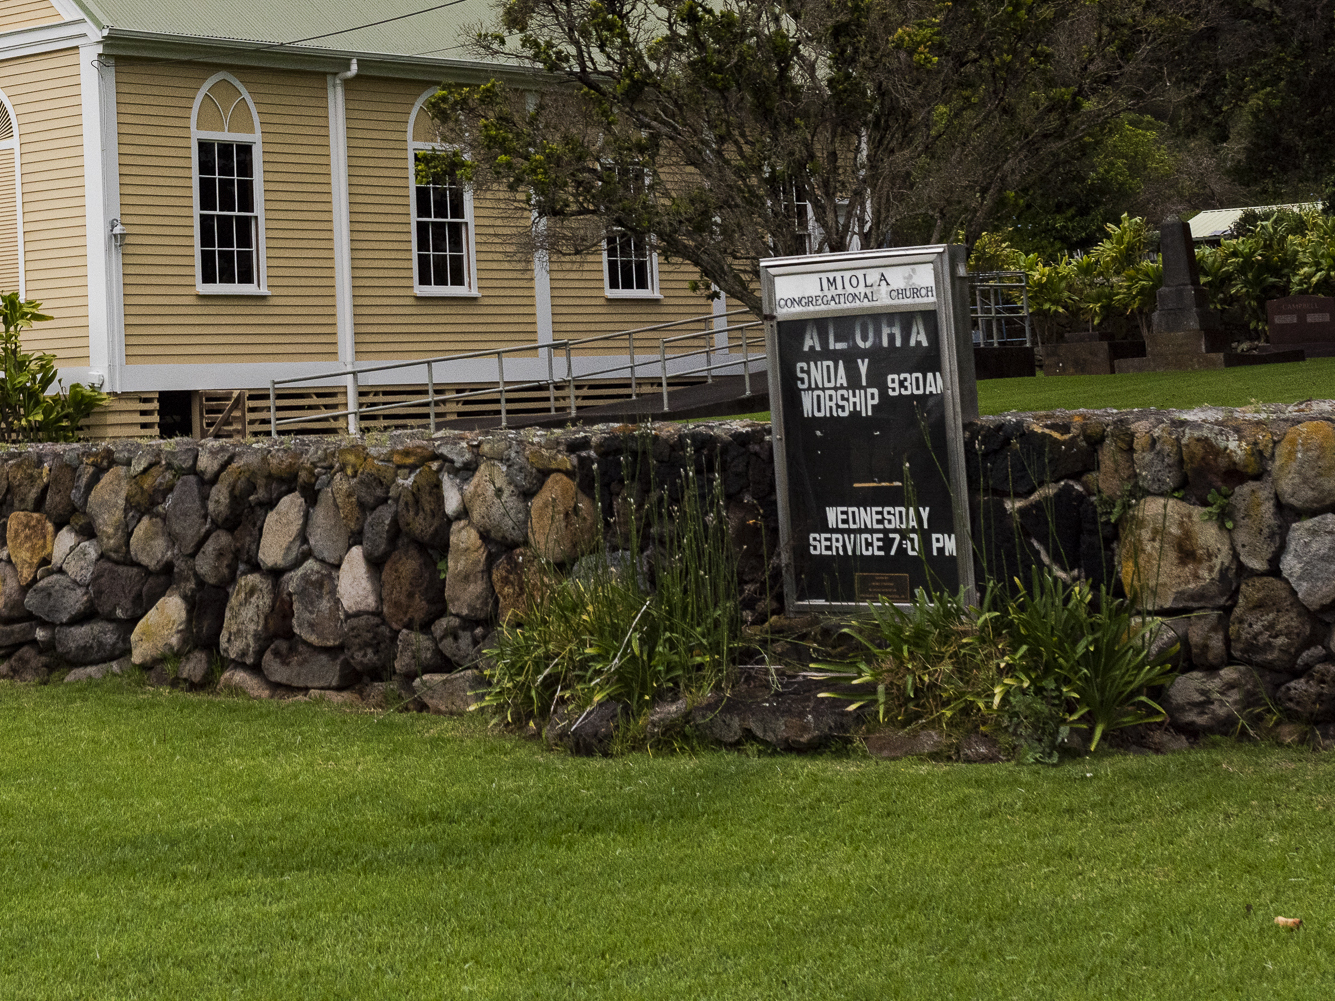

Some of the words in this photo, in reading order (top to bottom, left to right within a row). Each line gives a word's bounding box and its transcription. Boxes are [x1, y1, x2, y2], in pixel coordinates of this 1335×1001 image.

[819, 272, 890, 291] IMIOLA
[778, 291, 878, 309] CONGREGATIONAL
[889, 286, 935, 301] CHURCH
[803, 315, 928, 352] ALOHA
[801, 388, 879, 417] WORSHIP
[826, 507, 930, 529] WEDNESDAY
[809, 533, 885, 556] SERVICE
[932, 533, 958, 556] PM
